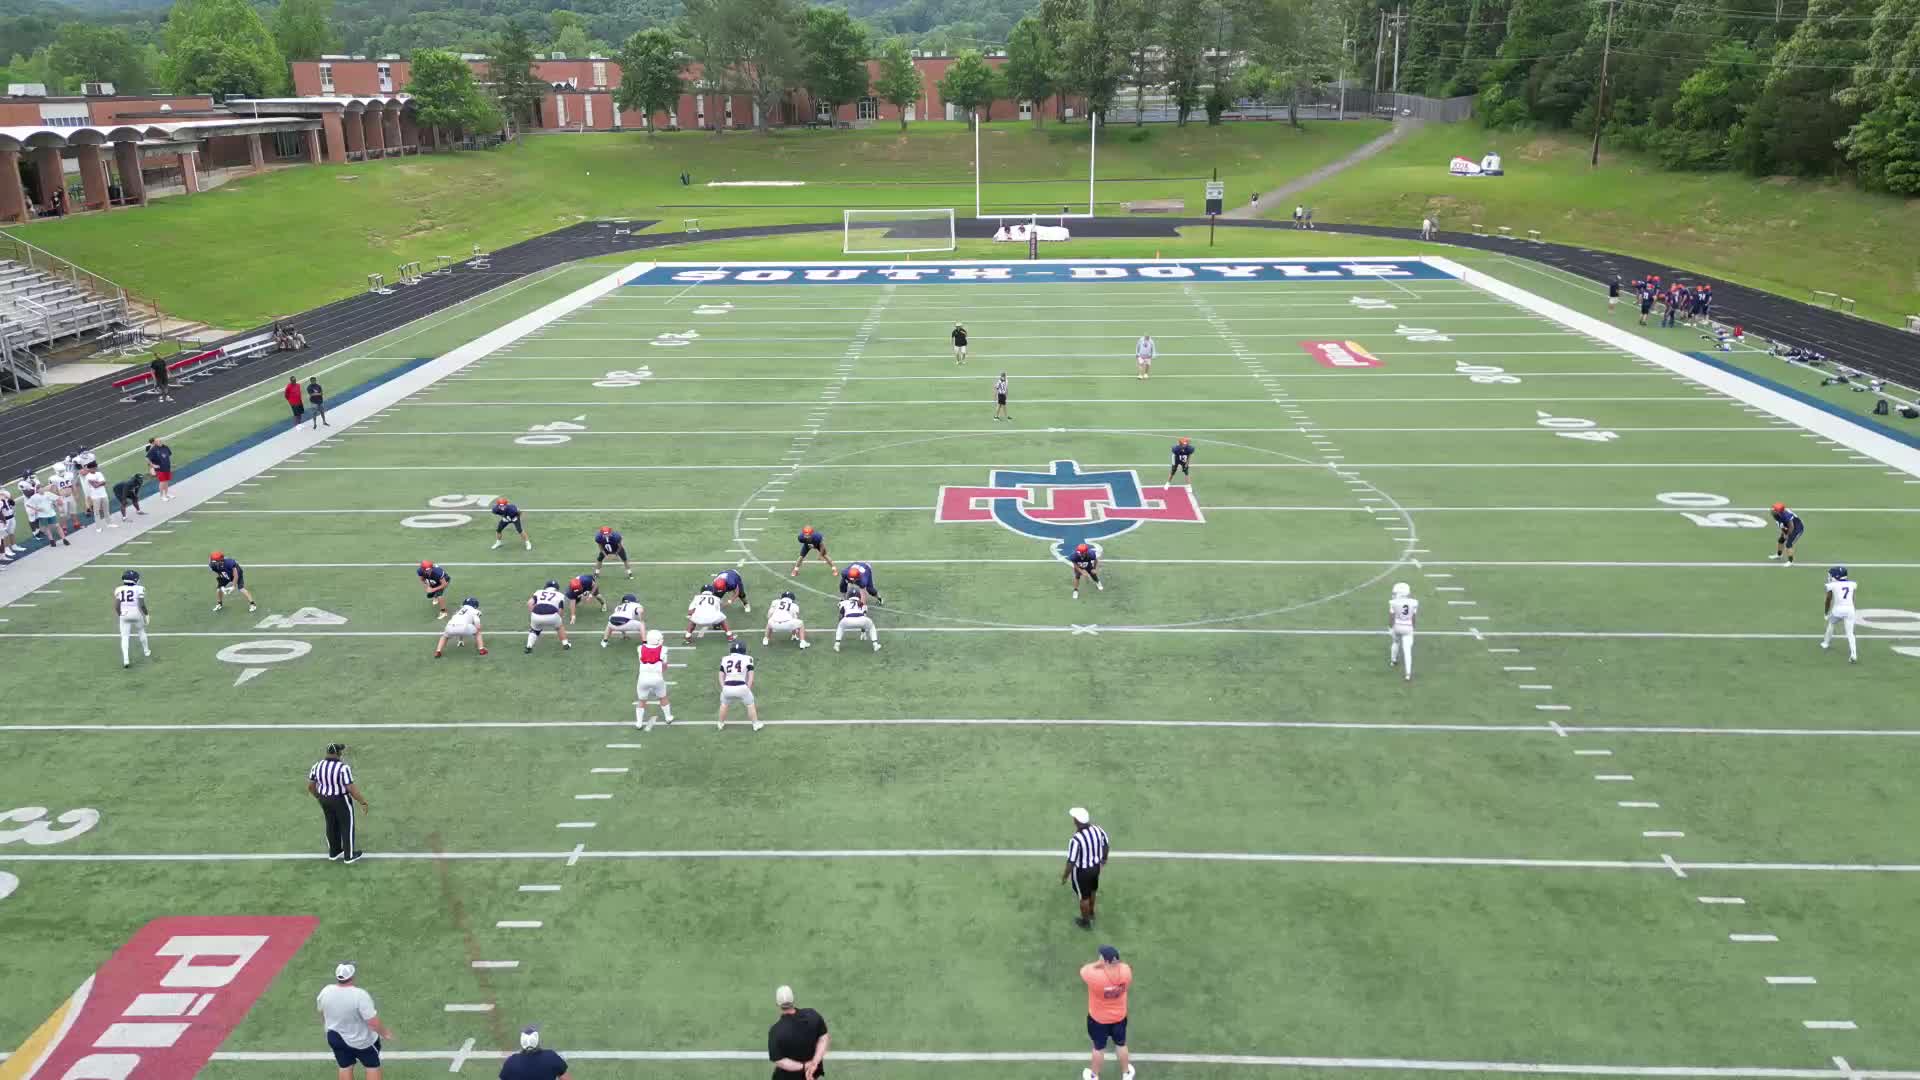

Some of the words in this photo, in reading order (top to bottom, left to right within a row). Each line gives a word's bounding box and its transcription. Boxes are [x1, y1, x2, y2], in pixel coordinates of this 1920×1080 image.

[400, 494, 500, 528] 50
[1656, 492, 1768, 528] 50
[119, 590, 134, 602] 12
[539, 591, 556, 602] 57
[1841, 587, 1850, 599] 7
[698, 596, 715, 606] 70
[778, 601, 792, 611] 51
[1402, 604, 1409, 615] 3
[215, 607, 349, 664] 40
[726, 660, 742, 673] 24
